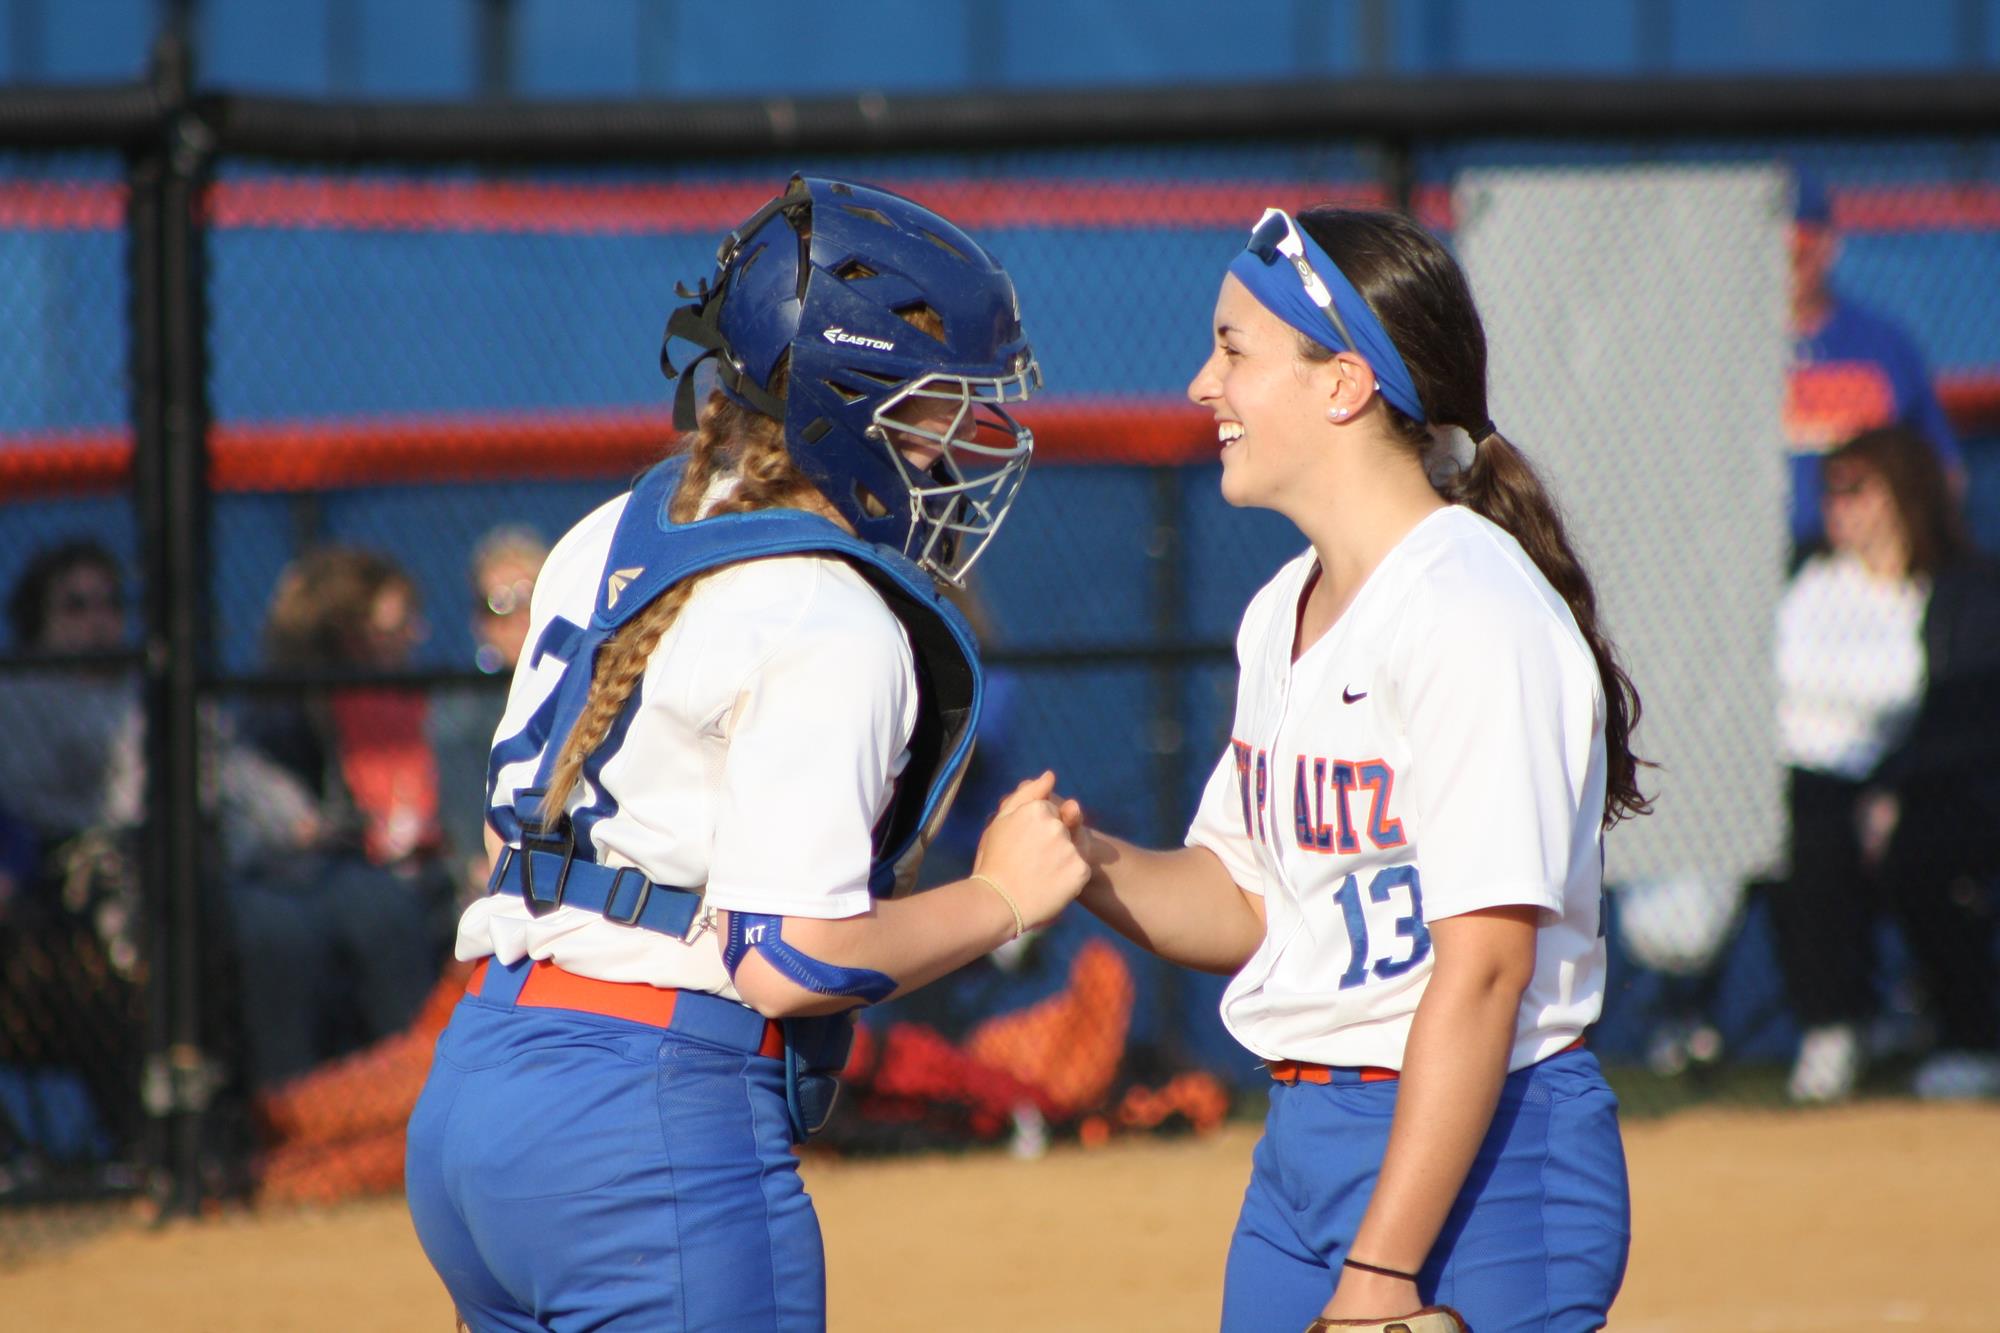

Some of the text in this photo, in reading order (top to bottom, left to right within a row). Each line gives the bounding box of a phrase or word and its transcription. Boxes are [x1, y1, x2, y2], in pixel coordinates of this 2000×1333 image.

[836, 333, 894, 351] EASTON
[744, 925, 766, 944] KT
[1333, 865, 1432, 990] 13
